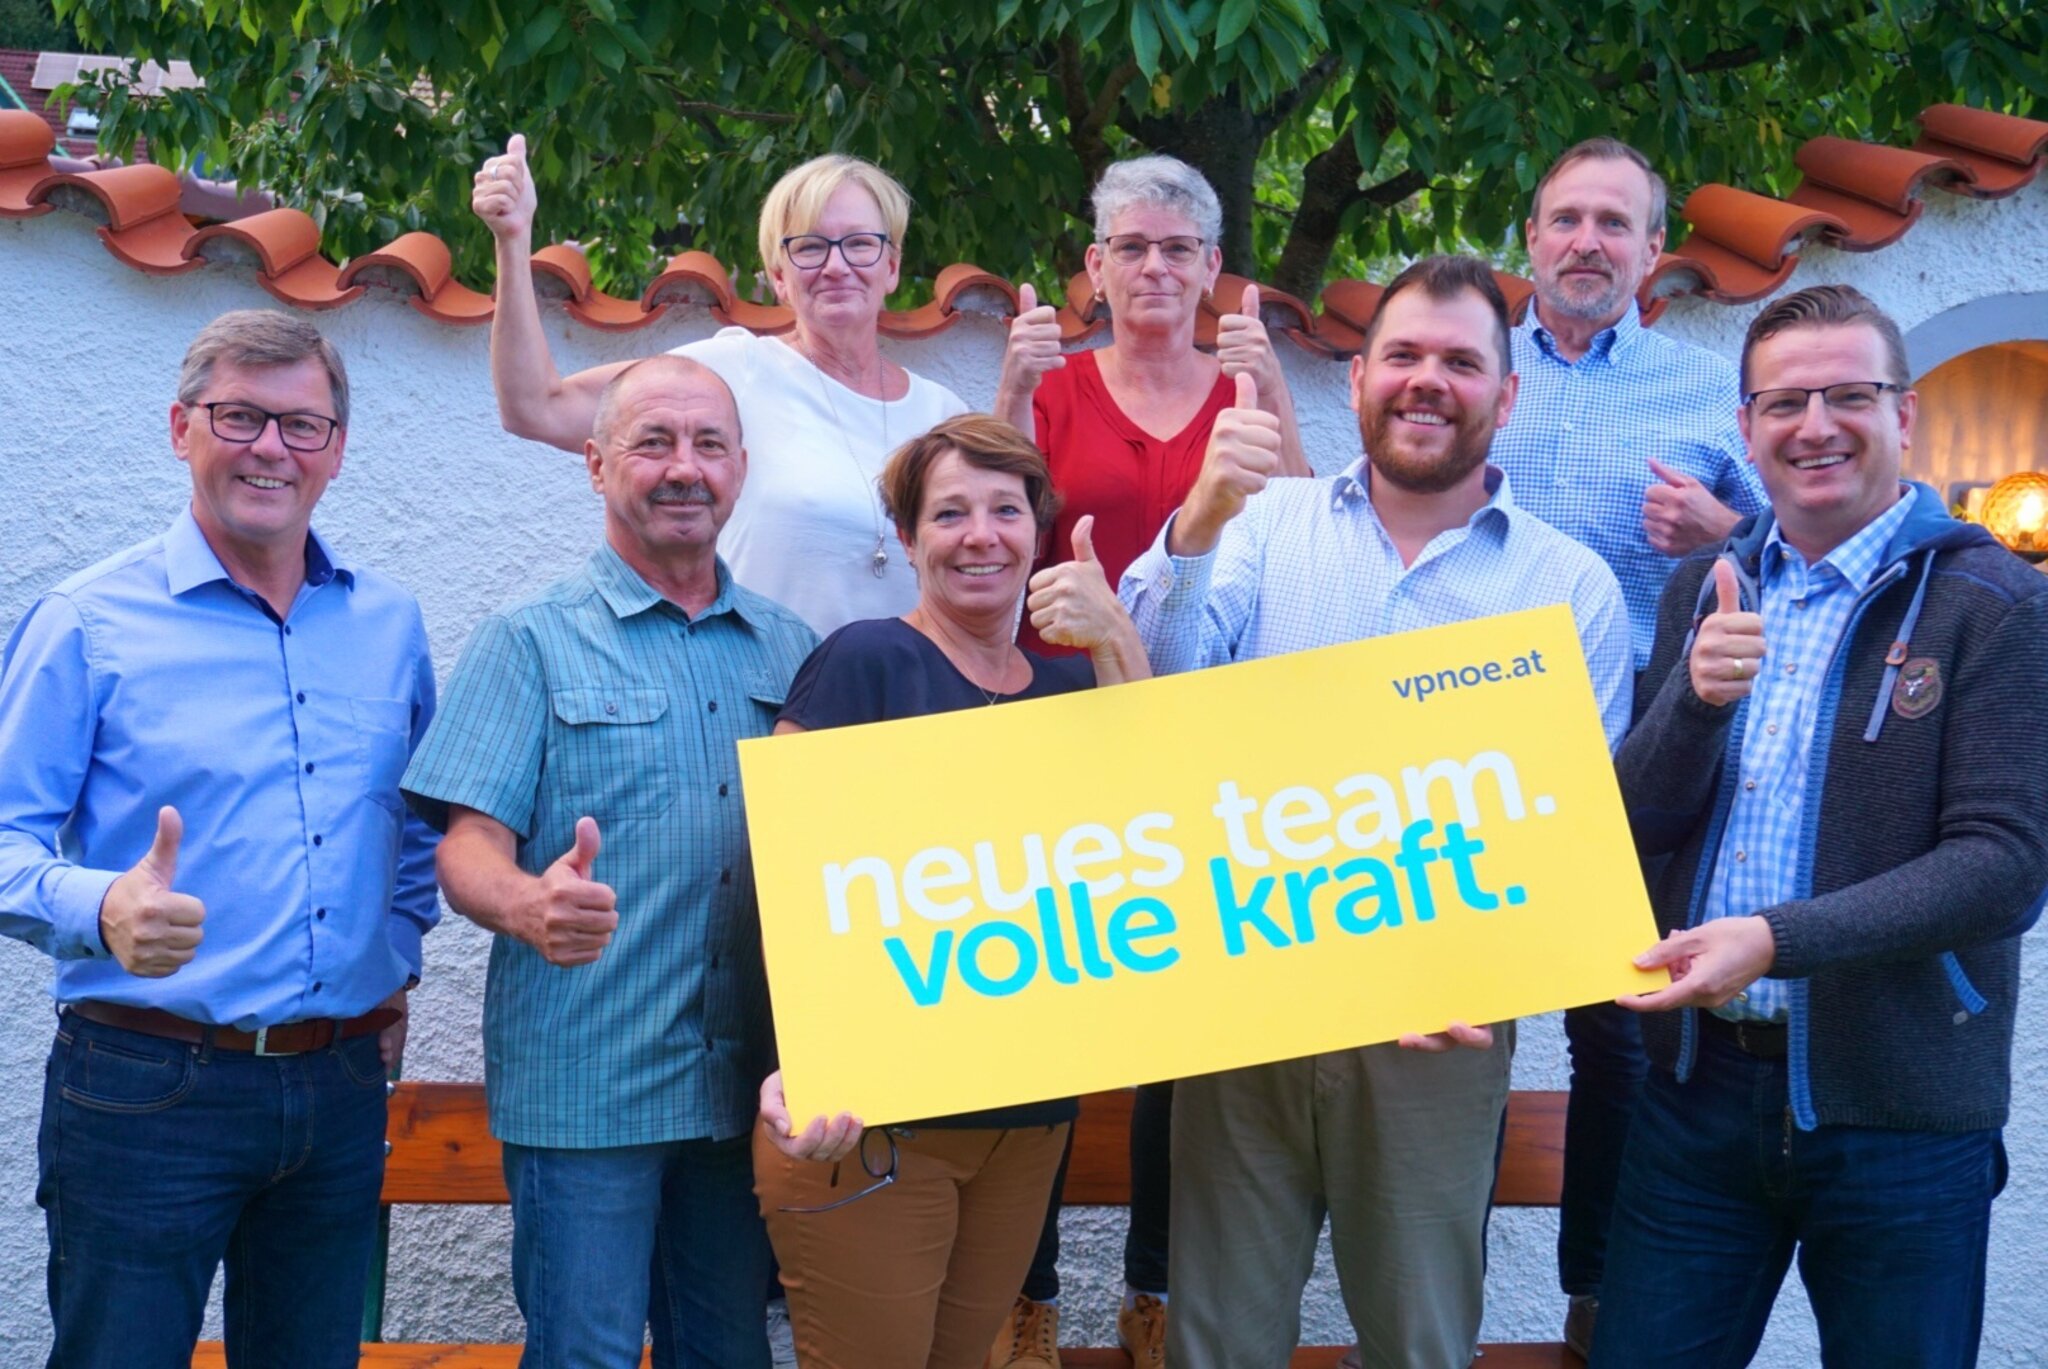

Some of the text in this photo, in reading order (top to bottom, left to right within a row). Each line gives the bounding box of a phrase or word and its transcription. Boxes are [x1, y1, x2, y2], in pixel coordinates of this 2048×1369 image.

[1392, 649, 1547, 704] vpnoe.at
[821, 748, 1558, 936] neues team.
[882, 817, 1529, 1008] volle kraft.
